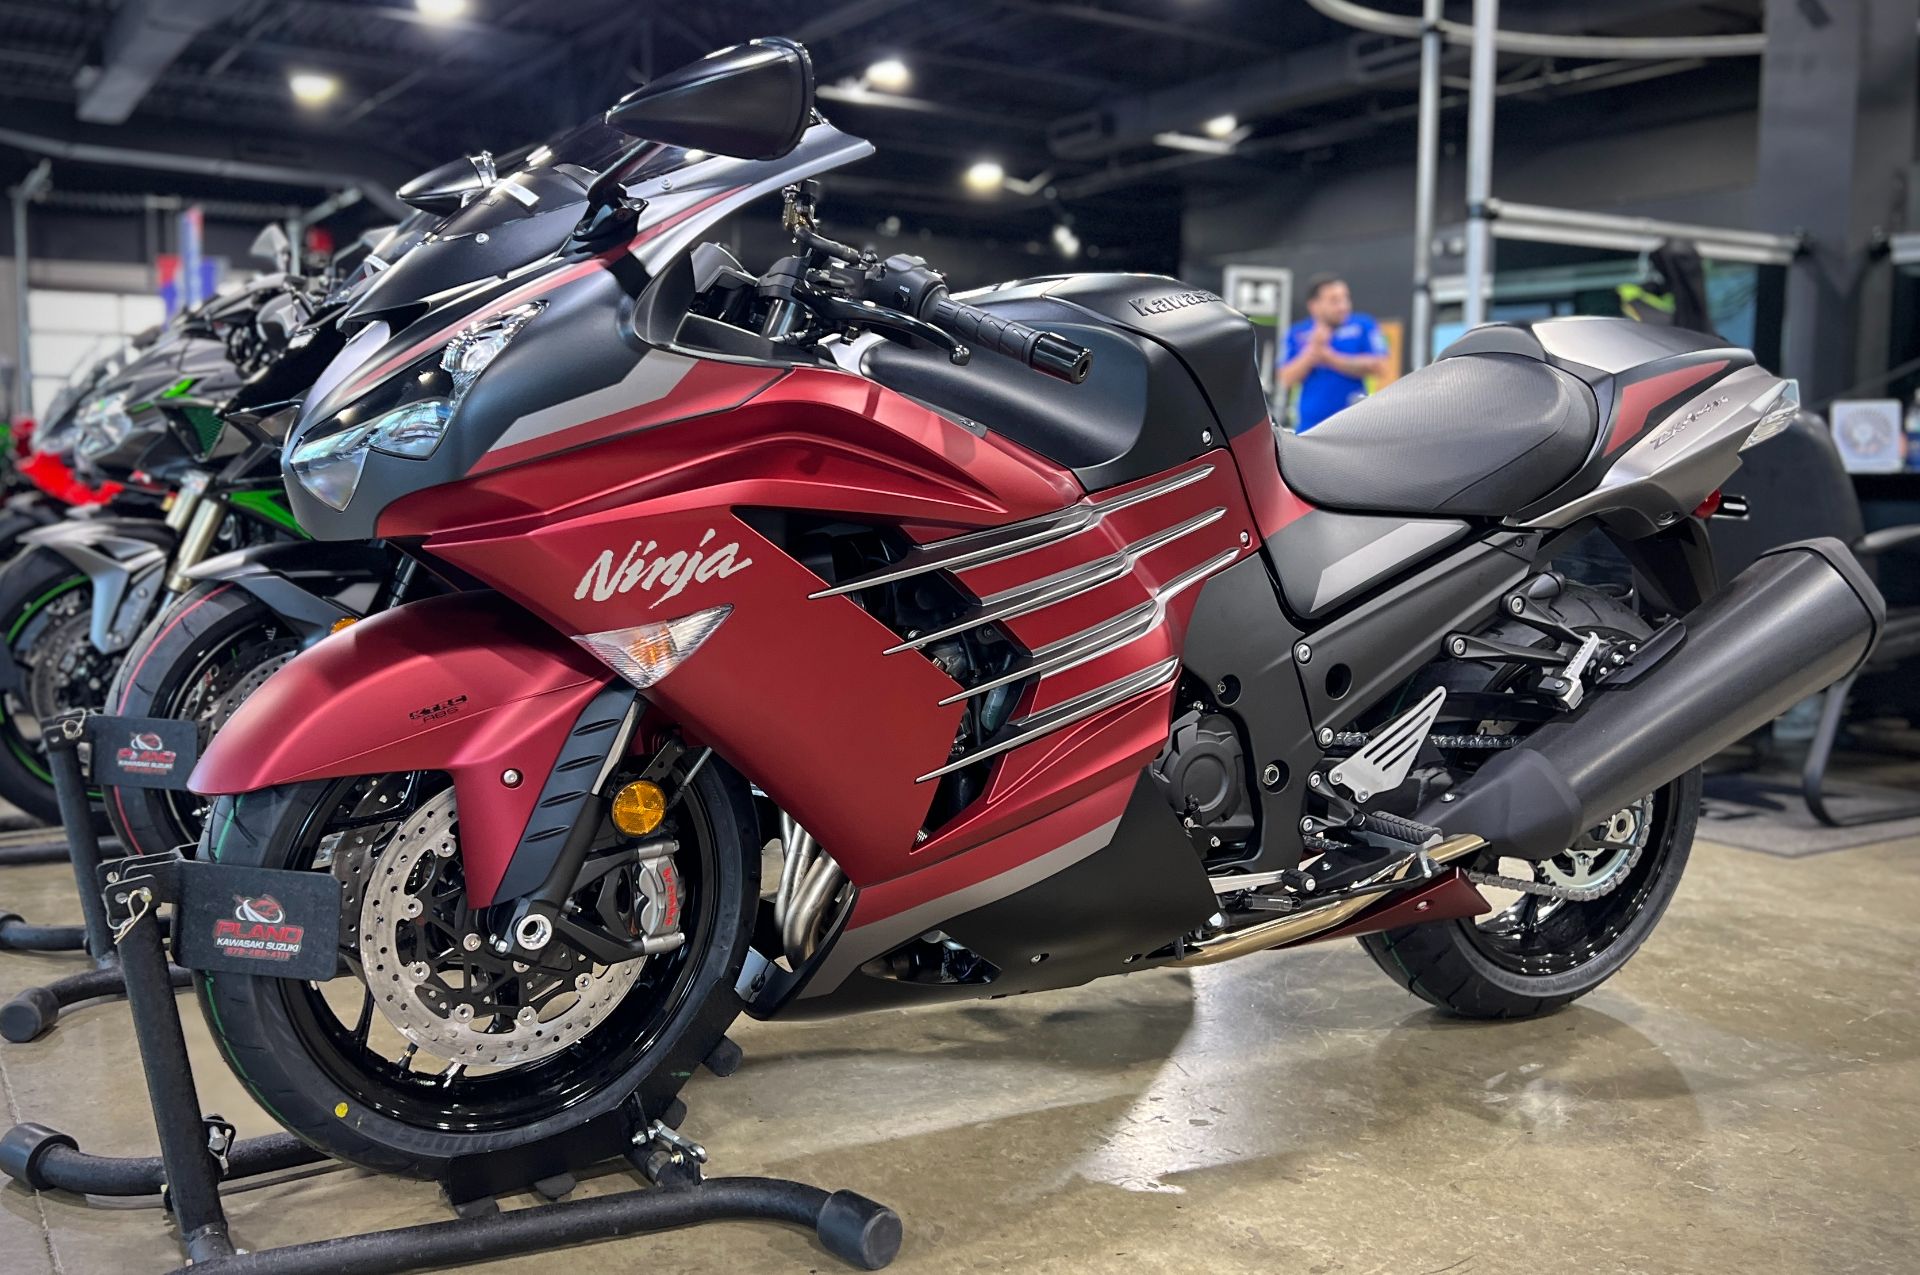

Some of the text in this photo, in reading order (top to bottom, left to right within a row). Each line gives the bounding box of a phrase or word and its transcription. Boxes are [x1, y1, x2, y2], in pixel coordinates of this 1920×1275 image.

[1128, 289, 1222, 317] Kawasa
[573, 528, 753, 609] Ninja
[215, 921, 303, 943] PLANO
[216, 938, 300, 952] KAWASAKI SUZUKI
